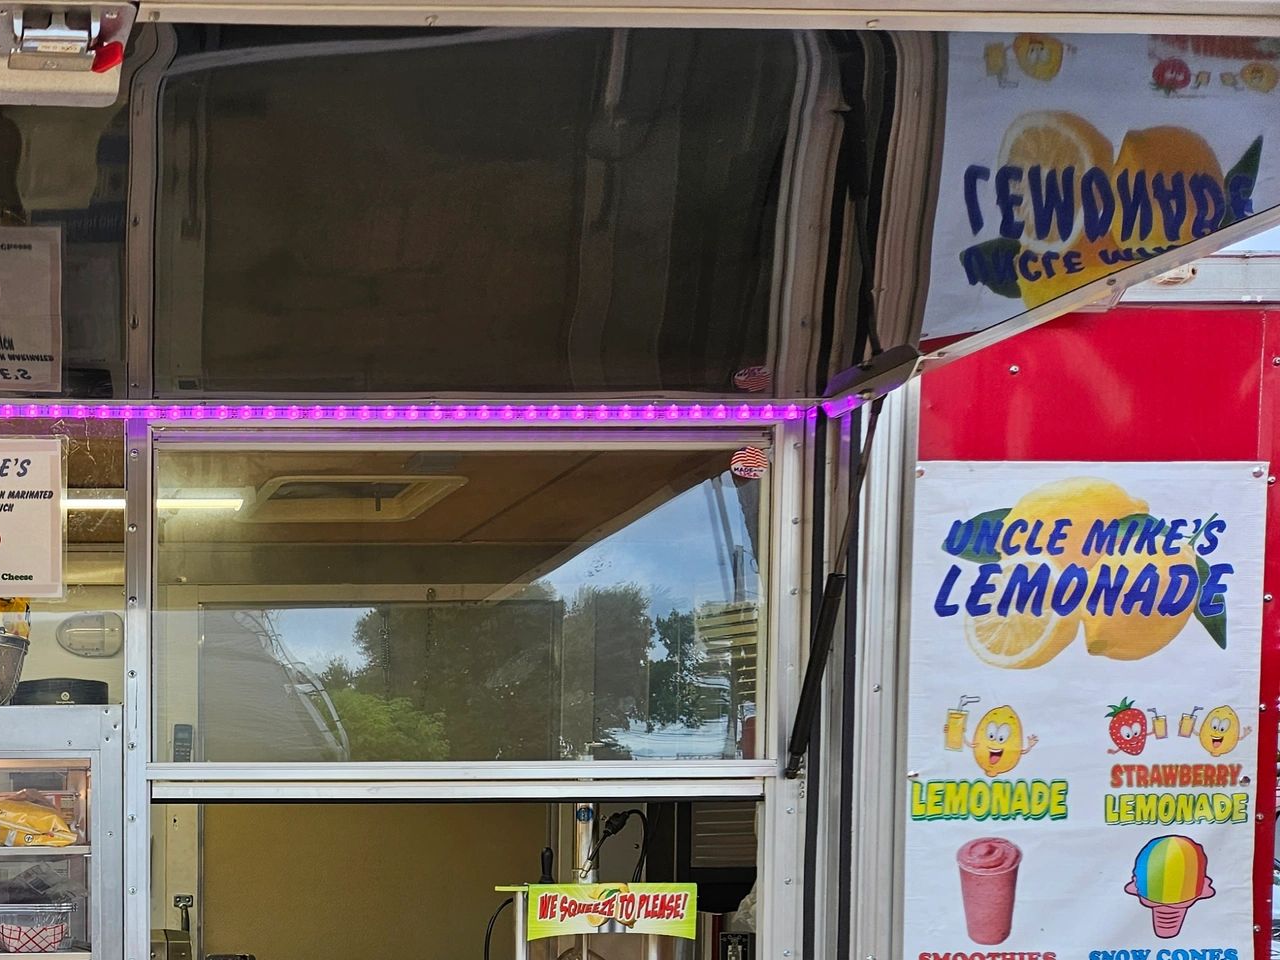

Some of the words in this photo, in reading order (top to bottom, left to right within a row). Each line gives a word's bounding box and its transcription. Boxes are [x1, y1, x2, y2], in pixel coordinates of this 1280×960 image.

[7, 490, 53, 499] MARINATED
[945, 518, 1072, 556] UNCLE
[1081, 518, 1227, 556] MIKE'S
[1, 573, 33, 581] Cheese
[934, 562, 1235, 618] LEMONADE
[1110, 763, 1240, 789] STRAWBERRY
[910, 779, 1068, 821] LEMONADE
[1105, 792, 1249, 825] LEMONADE
[539, 894, 558, 920] WE
[560, 895, 617, 922] SQUEEZE
[619, 893, 636, 920] TO
[637, 893, 689, 919] PLEASE!
